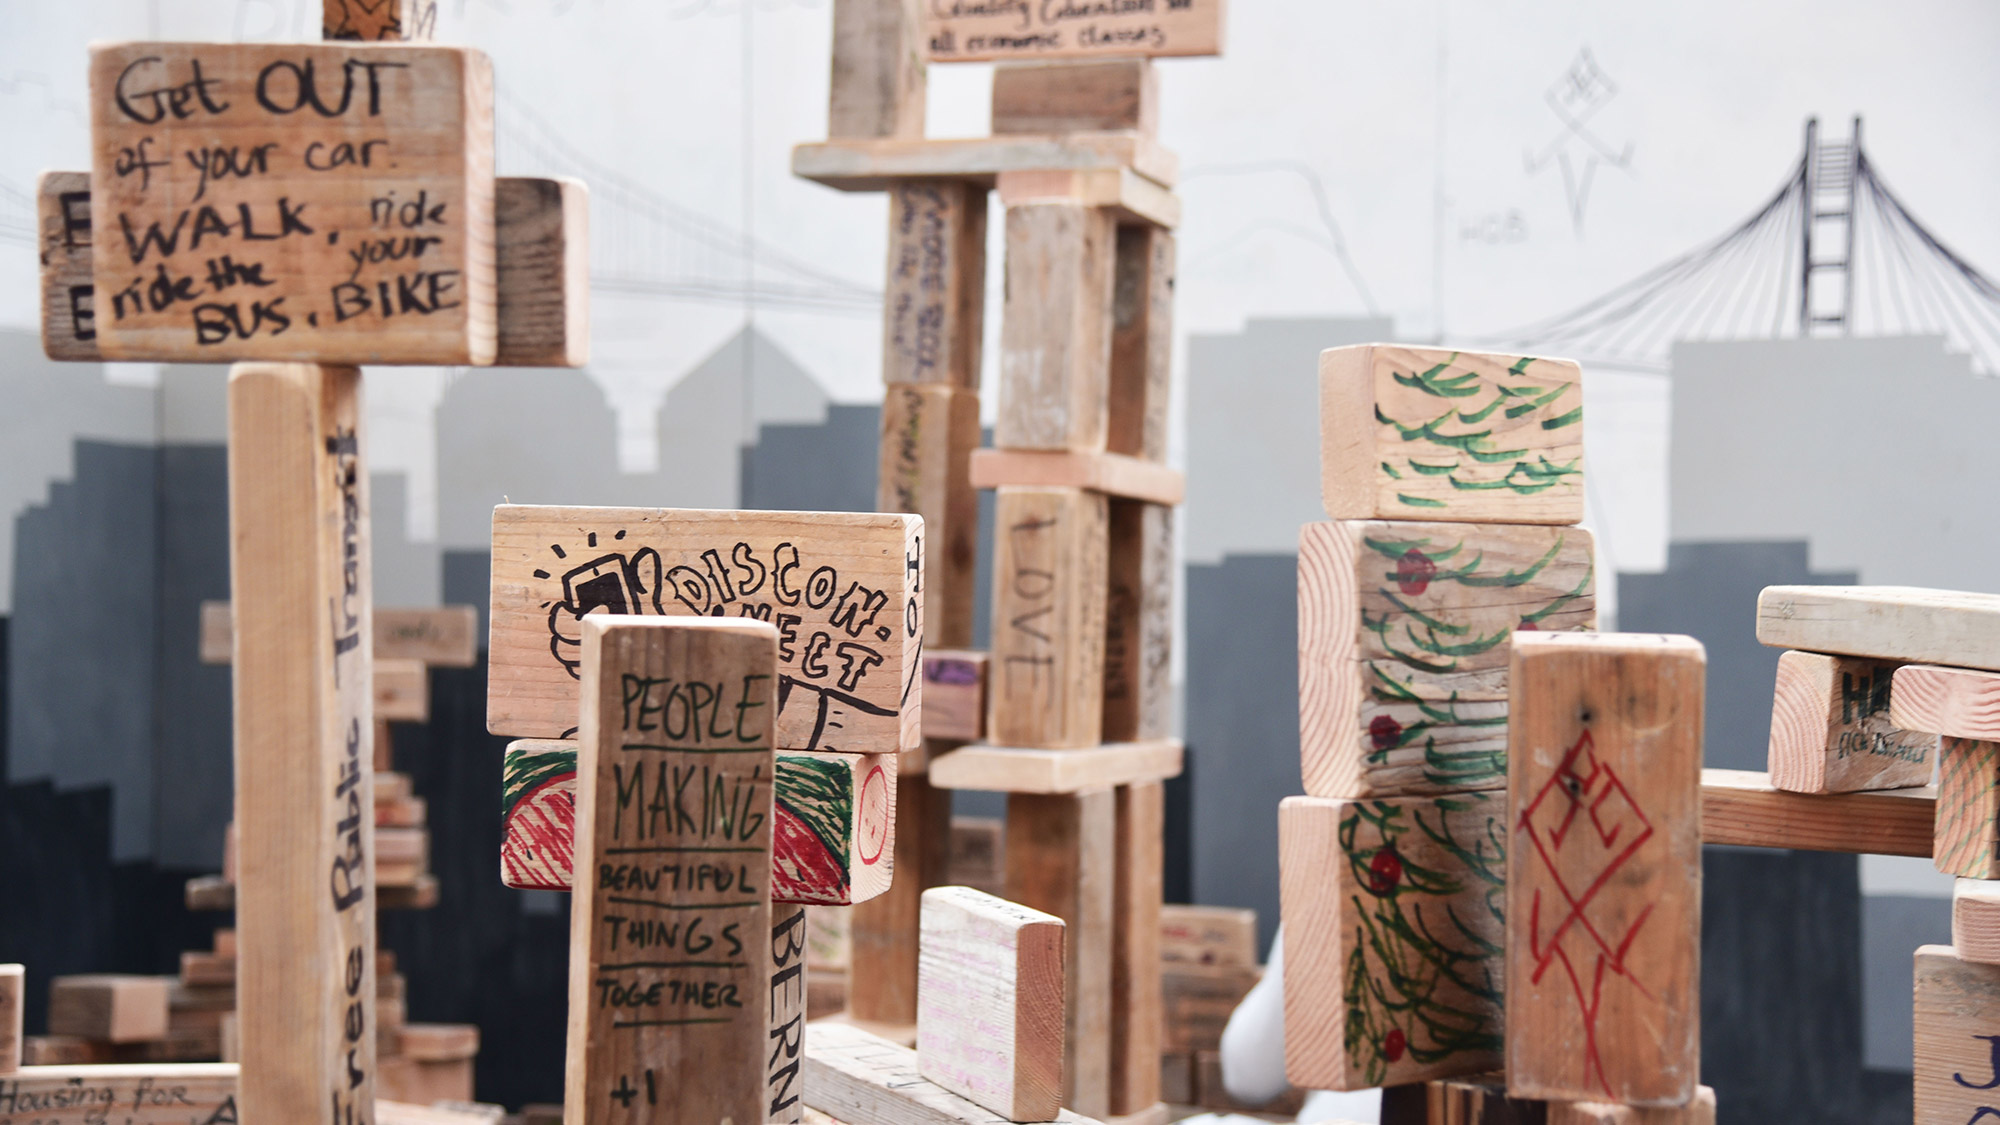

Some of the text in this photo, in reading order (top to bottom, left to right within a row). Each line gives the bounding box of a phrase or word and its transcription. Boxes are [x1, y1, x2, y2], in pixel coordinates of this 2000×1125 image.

[115, 56, 410, 125] Get OUT
[115, 137, 399, 201] of your car.
[371, 189, 448, 229] ride
[348, 235, 444, 282] your
[110, 254, 277, 321] ride the
[330, 269, 462, 323] BIKE
[621, 673, 771, 744] PEOPLE
[330, 716, 364, 914] Public
[613, 761, 765, 842] MAKING
[598, 863, 757, 895] BEAUTIFUL
[603, 915, 743, 958] THINGS
[595, 977, 743, 1010] TOGETHER
[769, 908, 806, 1125] BERN
[0, 1076, 115, 1117] Housing
[609, 1068, 657, 1108] +1
